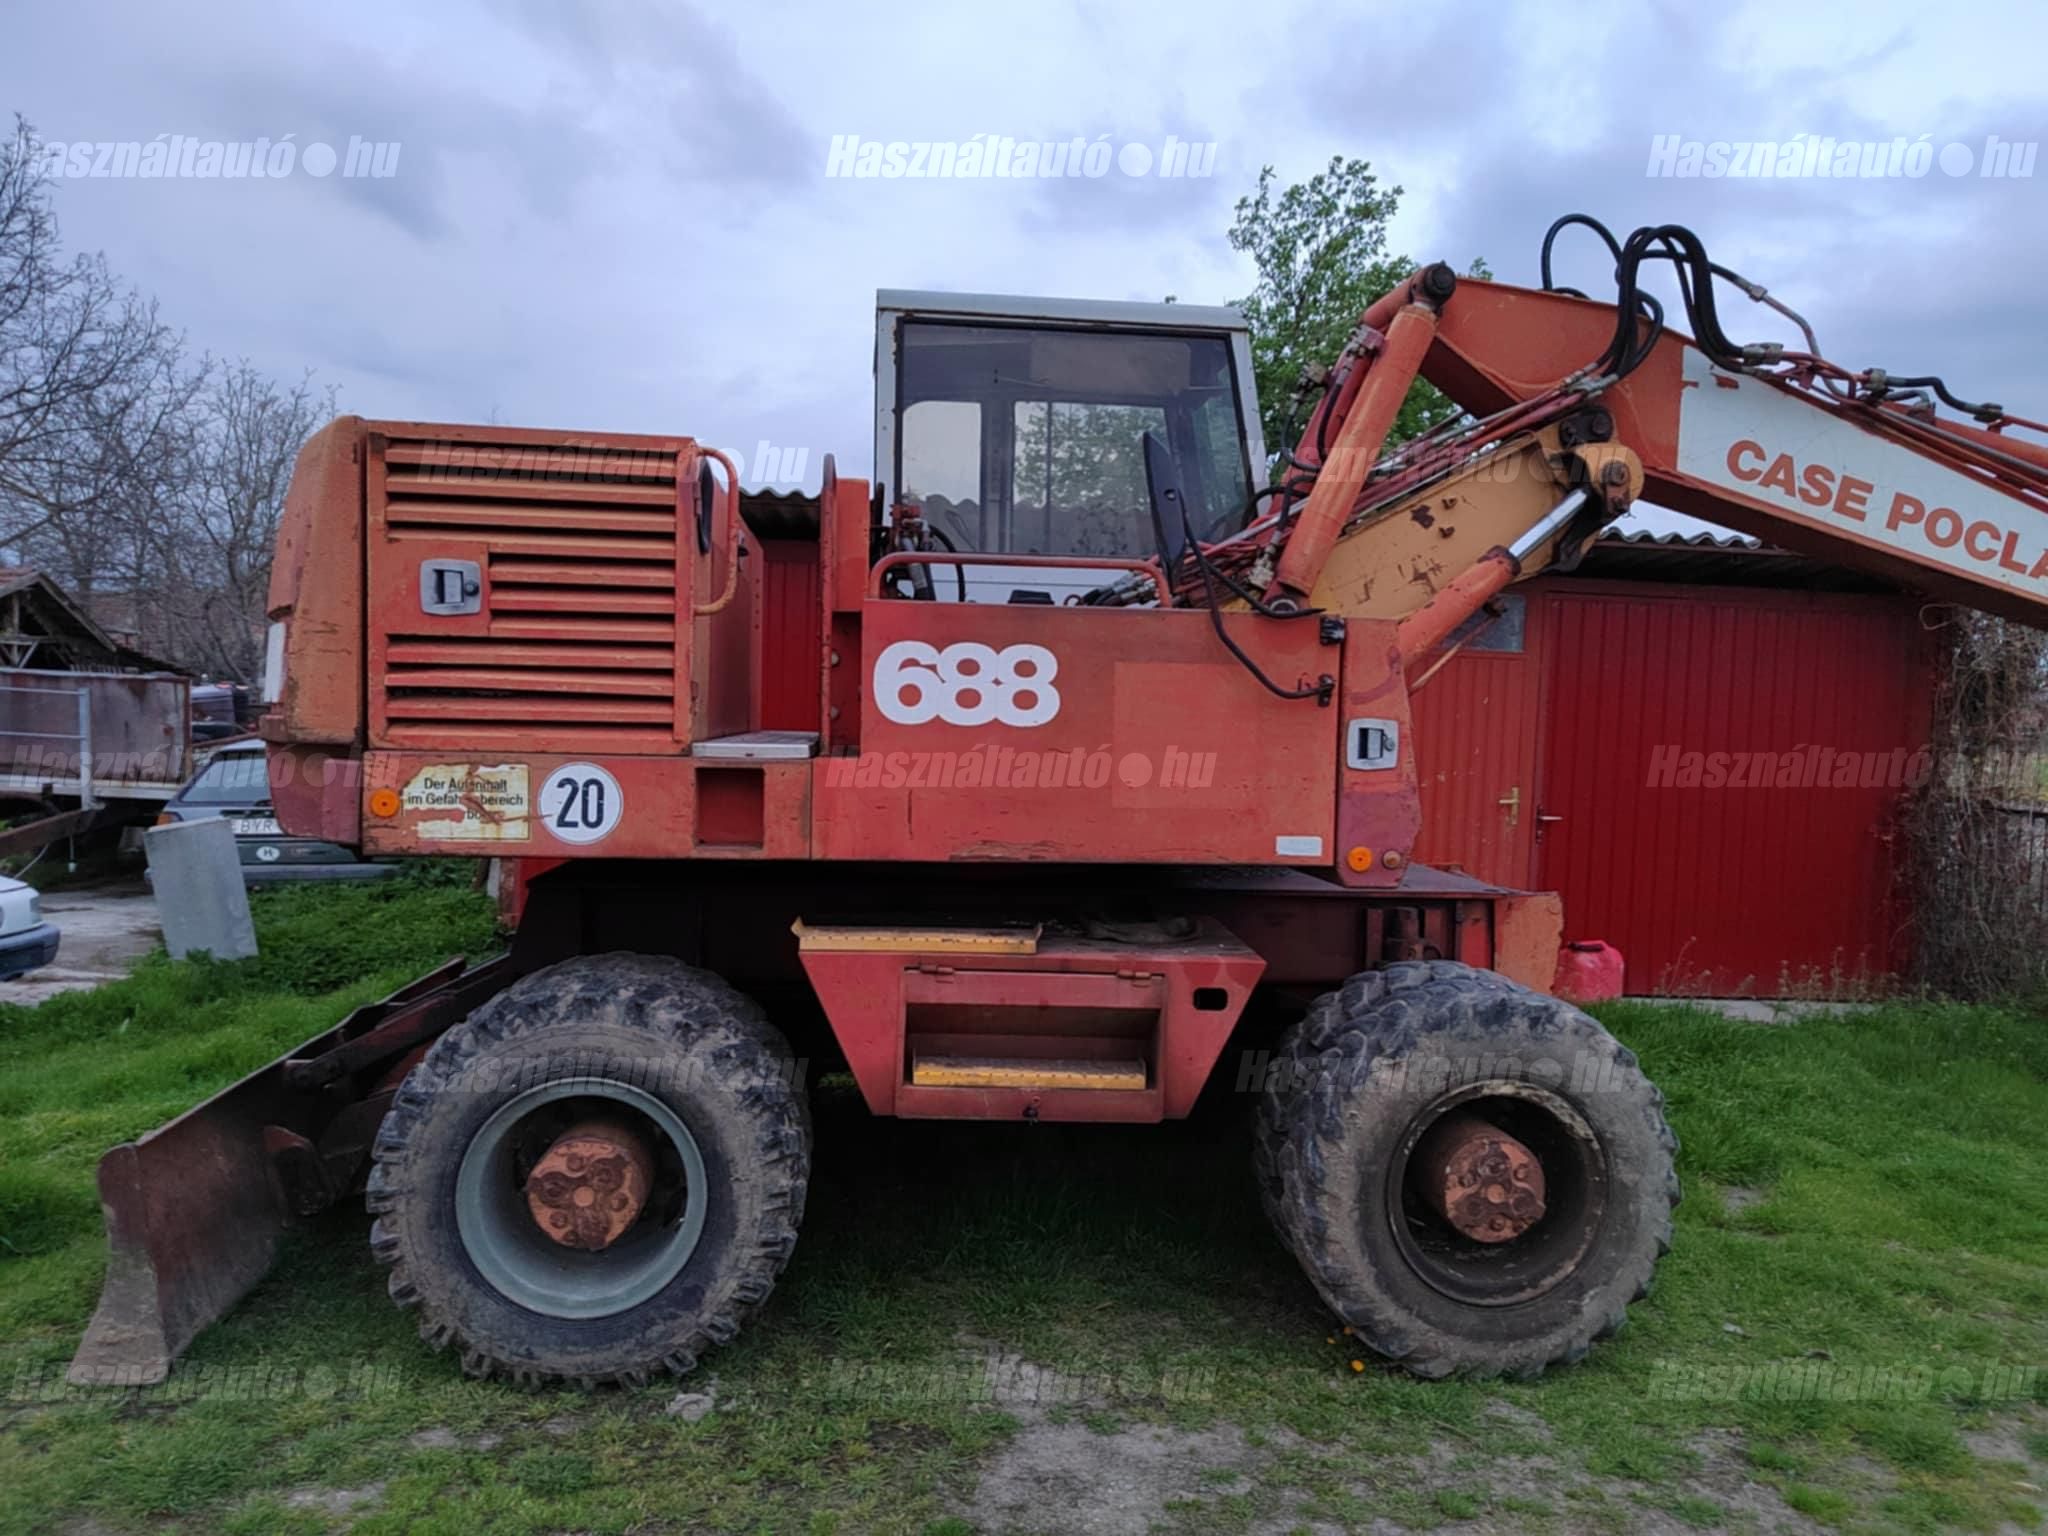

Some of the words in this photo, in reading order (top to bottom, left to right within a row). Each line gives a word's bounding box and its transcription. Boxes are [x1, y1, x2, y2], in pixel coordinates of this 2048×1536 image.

[1726, 440, 1874, 522] CASE
[872, 641, 1061, 728] 688
[408, 792, 423, 805] im
[425, 792, 524, 806] Gefahbereich
[424, 777, 445, 790] Der
[448, 777, 507, 792] Aunthalt
[556, 777, 605, 829] 20
